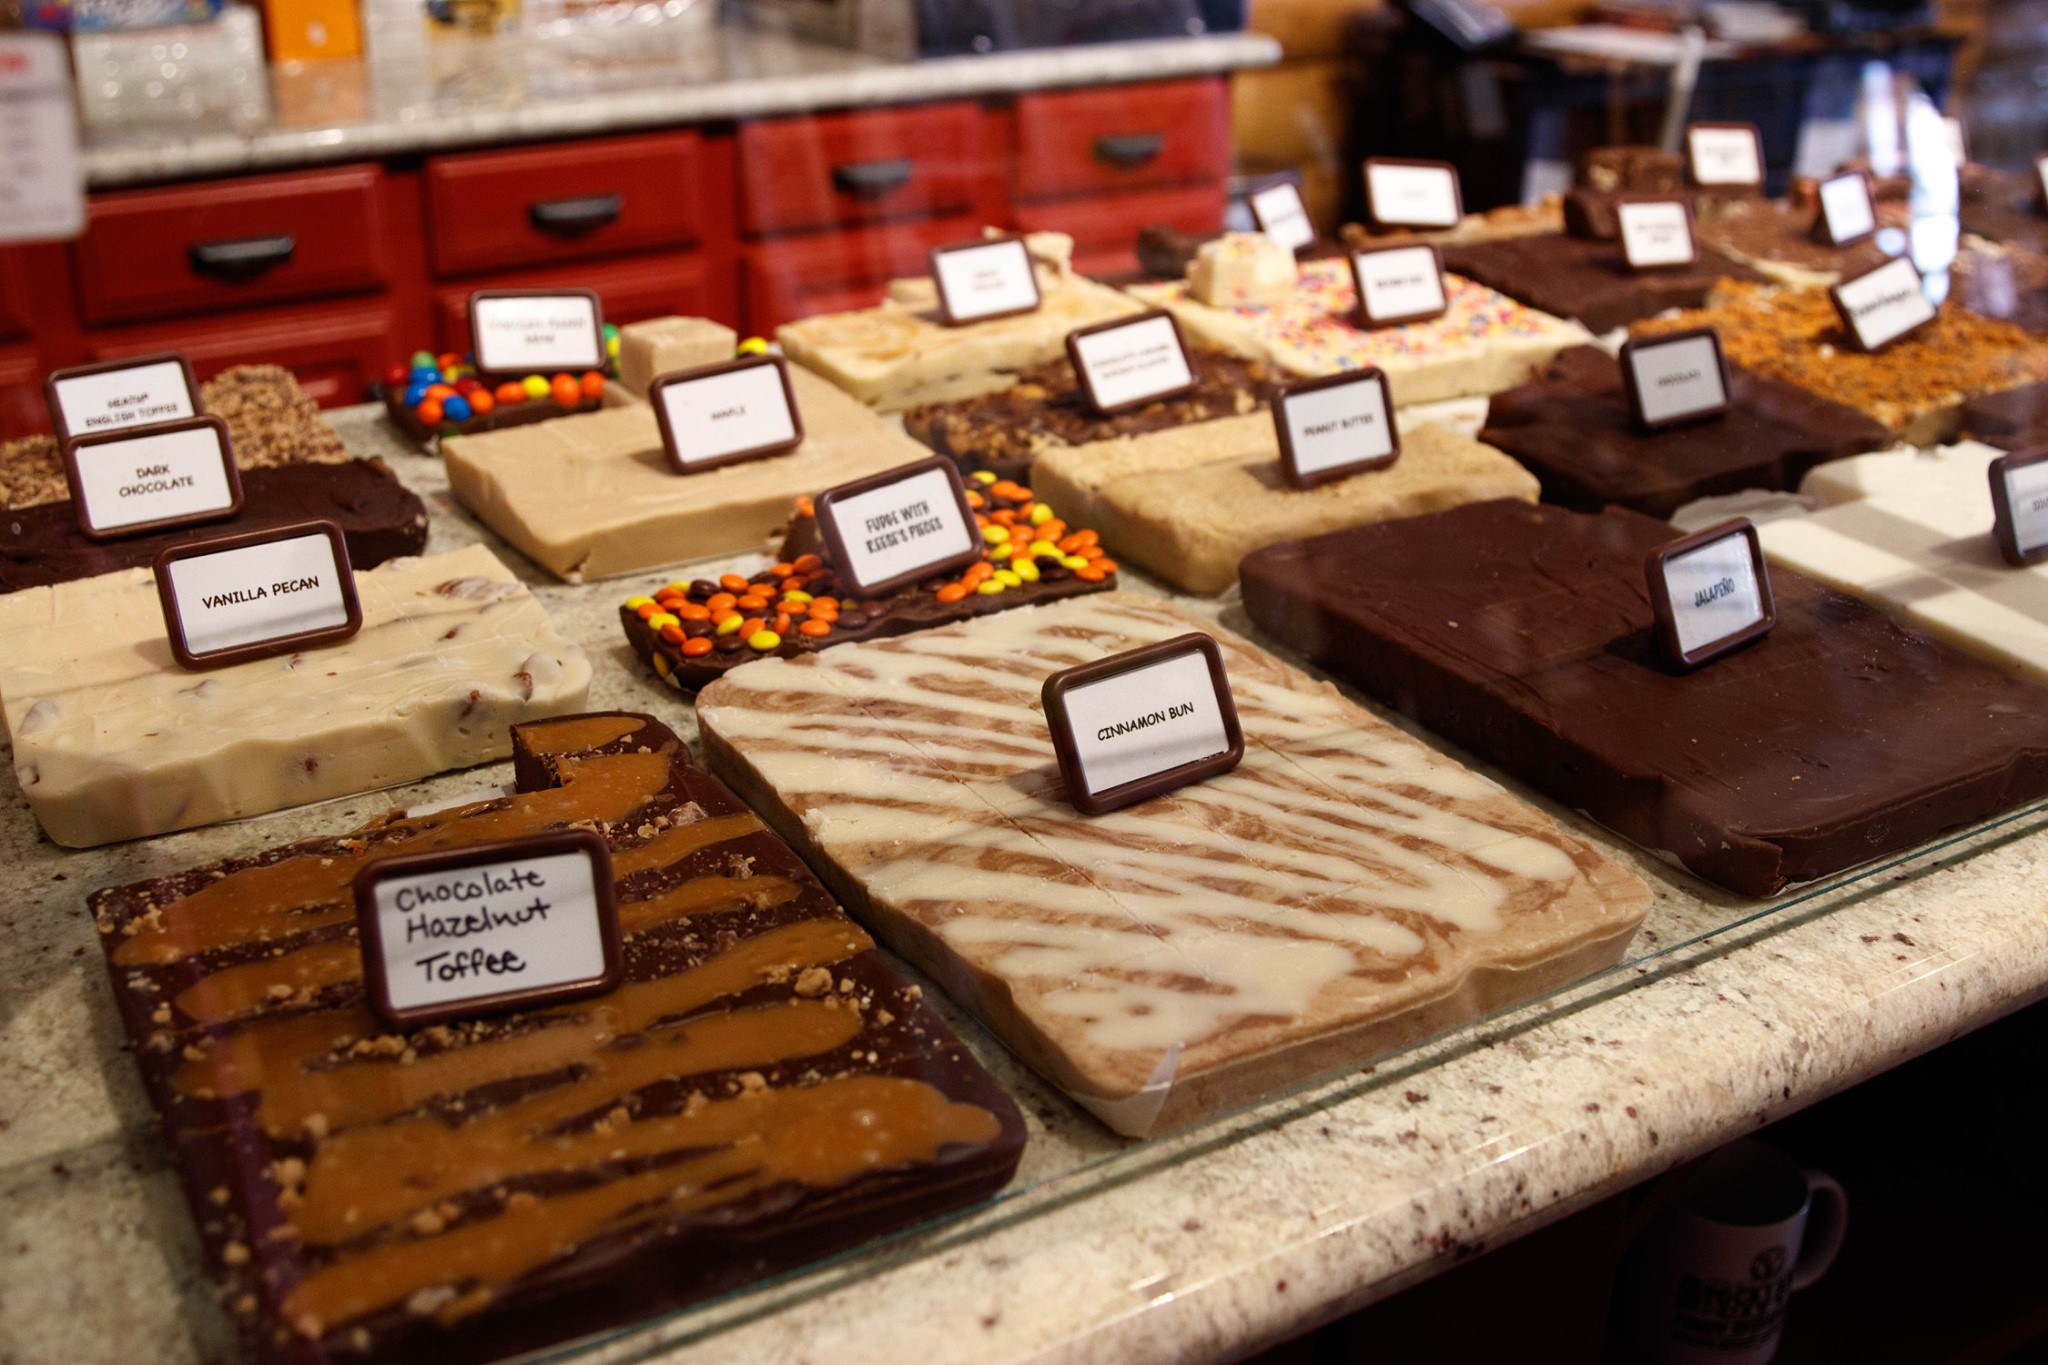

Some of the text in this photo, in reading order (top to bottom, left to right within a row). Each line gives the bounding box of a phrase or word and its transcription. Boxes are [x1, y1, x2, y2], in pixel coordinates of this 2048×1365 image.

[85, 403, 178, 428] ENGLISH TOFFEE
[1303, 413, 1374, 437] PEANUT BUTTER
[119, 476, 194, 498] CHOCOLATE
[136, 465, 171, 480] DARK
[866, 501, 930, 532] FUDGE WITH
[866, 520, 943, 554] REESE'S PIECES
[202, 576, 319, 609] VANILLA PECAN
[1694, 578, 1735, 608] JALAPEÑO
[1098, 702, 1194, 741] CINNAMON BUN
[394, 868, 546, 913] Chocolate
[406, 899, 551, 943] Hazelnut
[415, 947, 527, 982] Toffee
